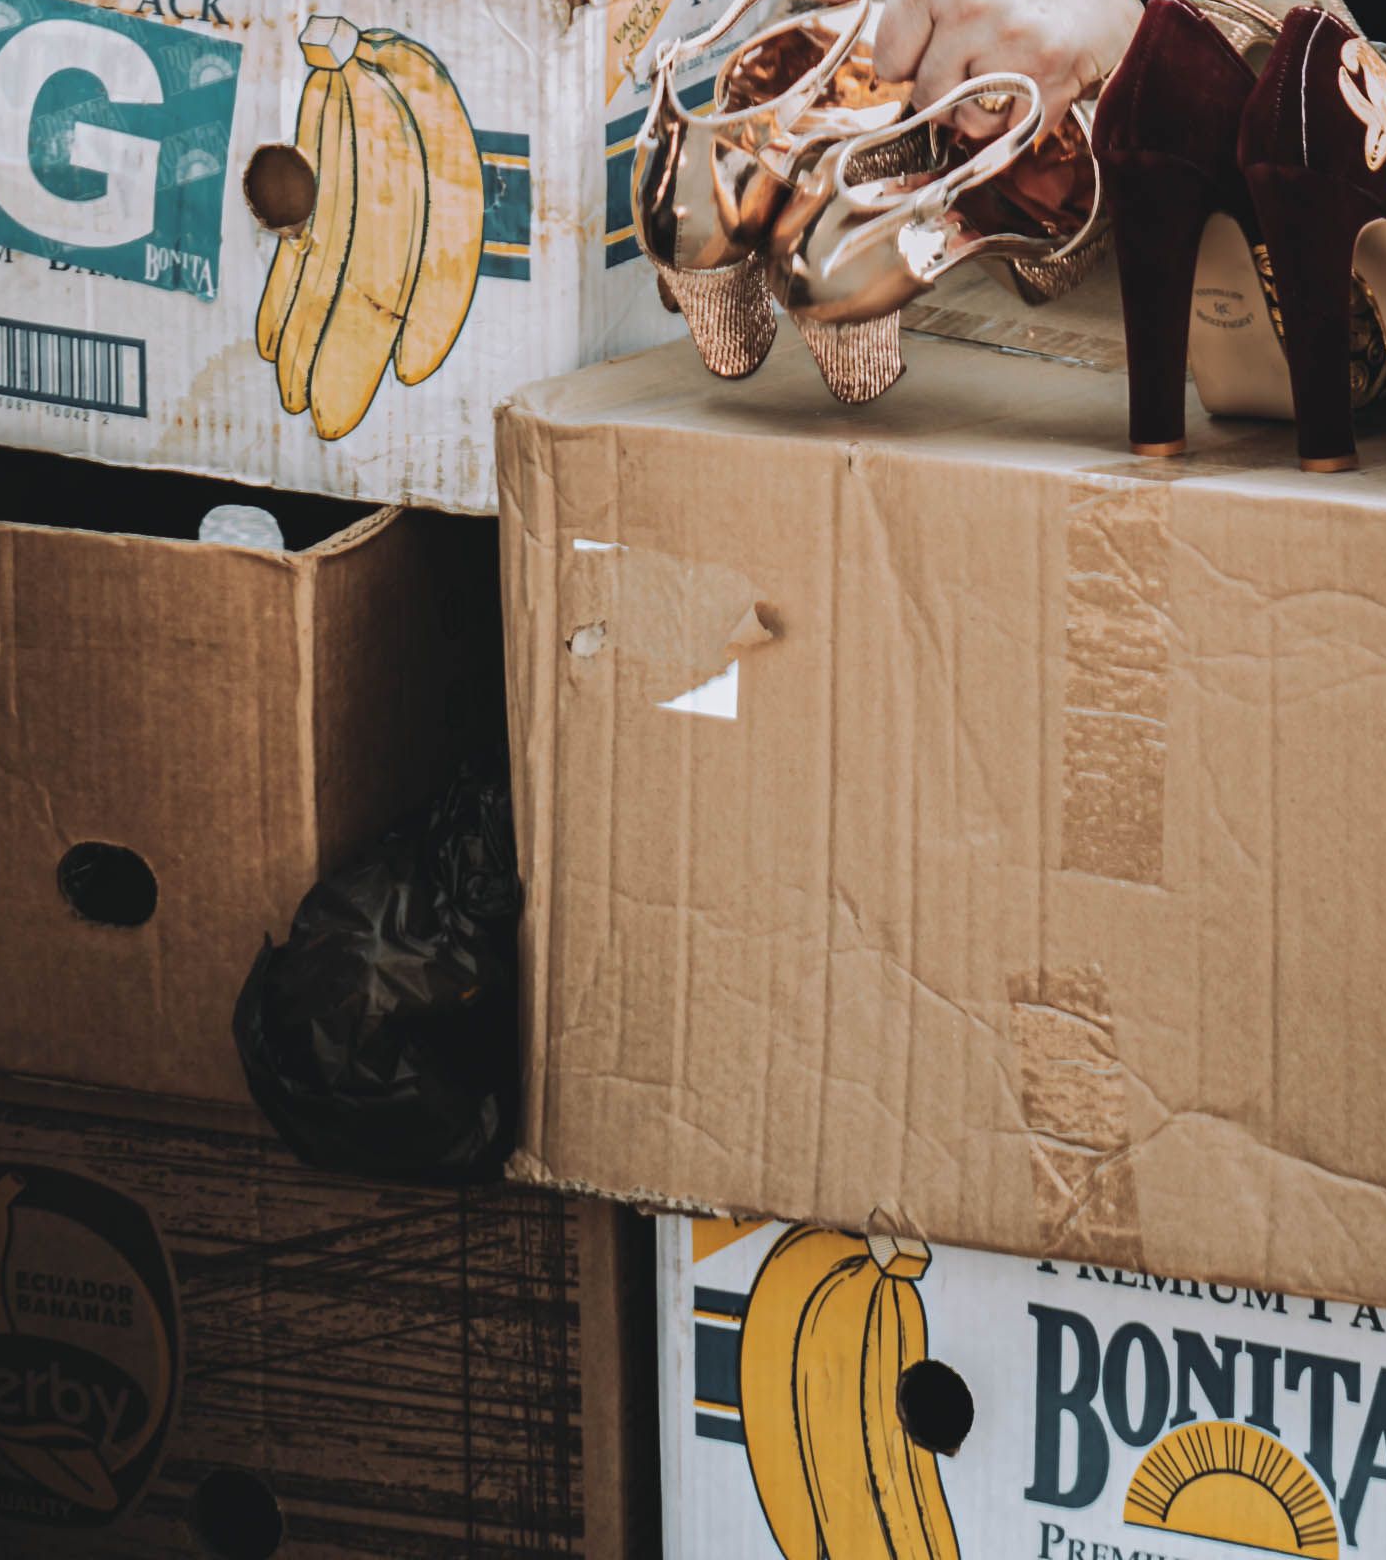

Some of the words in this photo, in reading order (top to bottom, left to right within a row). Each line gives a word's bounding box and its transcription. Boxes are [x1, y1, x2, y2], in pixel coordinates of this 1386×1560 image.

[629, 0, 661, 50] PACK
[145, 243, 215, 298] BONITA
[15, 1271, 134, 1305] ECUADOR
[15, 1293, 134, 1329] BANANAS
